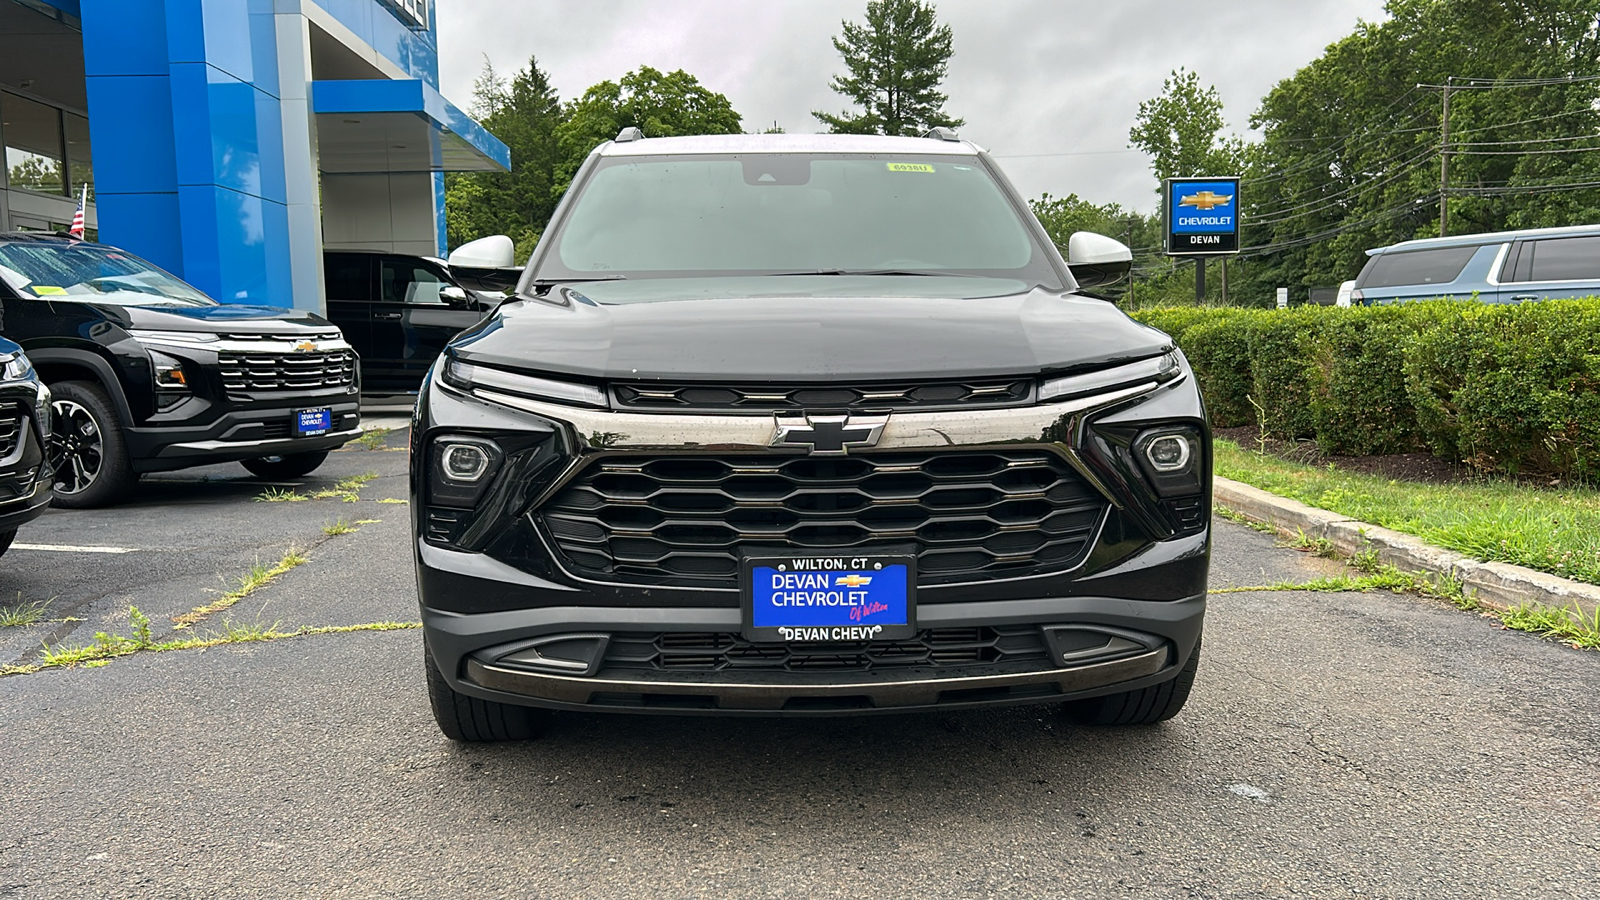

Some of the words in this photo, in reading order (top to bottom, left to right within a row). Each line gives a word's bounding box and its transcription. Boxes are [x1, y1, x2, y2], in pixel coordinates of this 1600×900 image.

[1178, 216, 1232, 226] CHEVROLET
[1190, 235, 1220, 244] DEVAN
[792, 558, 847, 571] WILTON,
[851, 558, 868, 570] CT
[772, 574, 829, 589] DEVAN
[772, 591, 868, 607] CHEVROLET
[863, 601, 889, 617] Wilton
[785, 627, 829, 640] DEVAN
[831, 626, 876, 640] CHEVY
